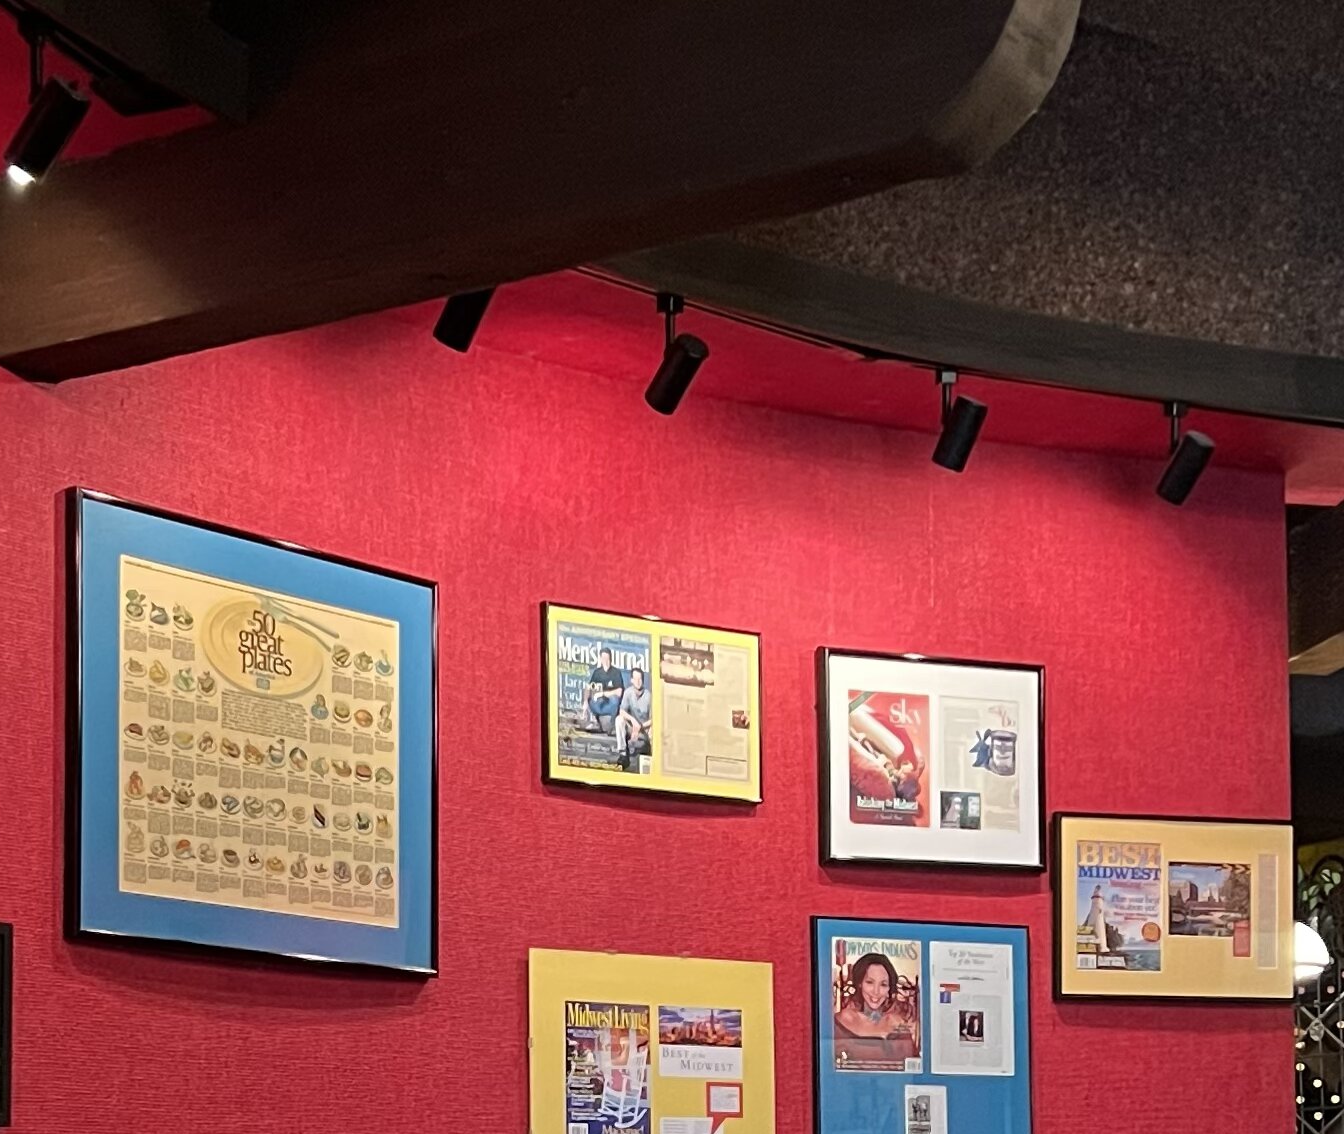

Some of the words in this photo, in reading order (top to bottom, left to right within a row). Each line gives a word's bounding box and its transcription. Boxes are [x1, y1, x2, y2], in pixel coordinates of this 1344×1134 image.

[252, 609, 276, 637] 50
[238, 629, 285, 657] great
[558, 636, 598, 667] Men's
[597, 641, 650, 673] Jurnal
[241, 645, 293, 677] plates
[1078, 843, 1161, 867] BEST
[1078, 865, 1161, 881] MIDWEST
[567, 1002, 613, 1028] Midwest
[614, 1005, 649, 1035] Living
[680, 1059, 734, 1072] MIDWEST
